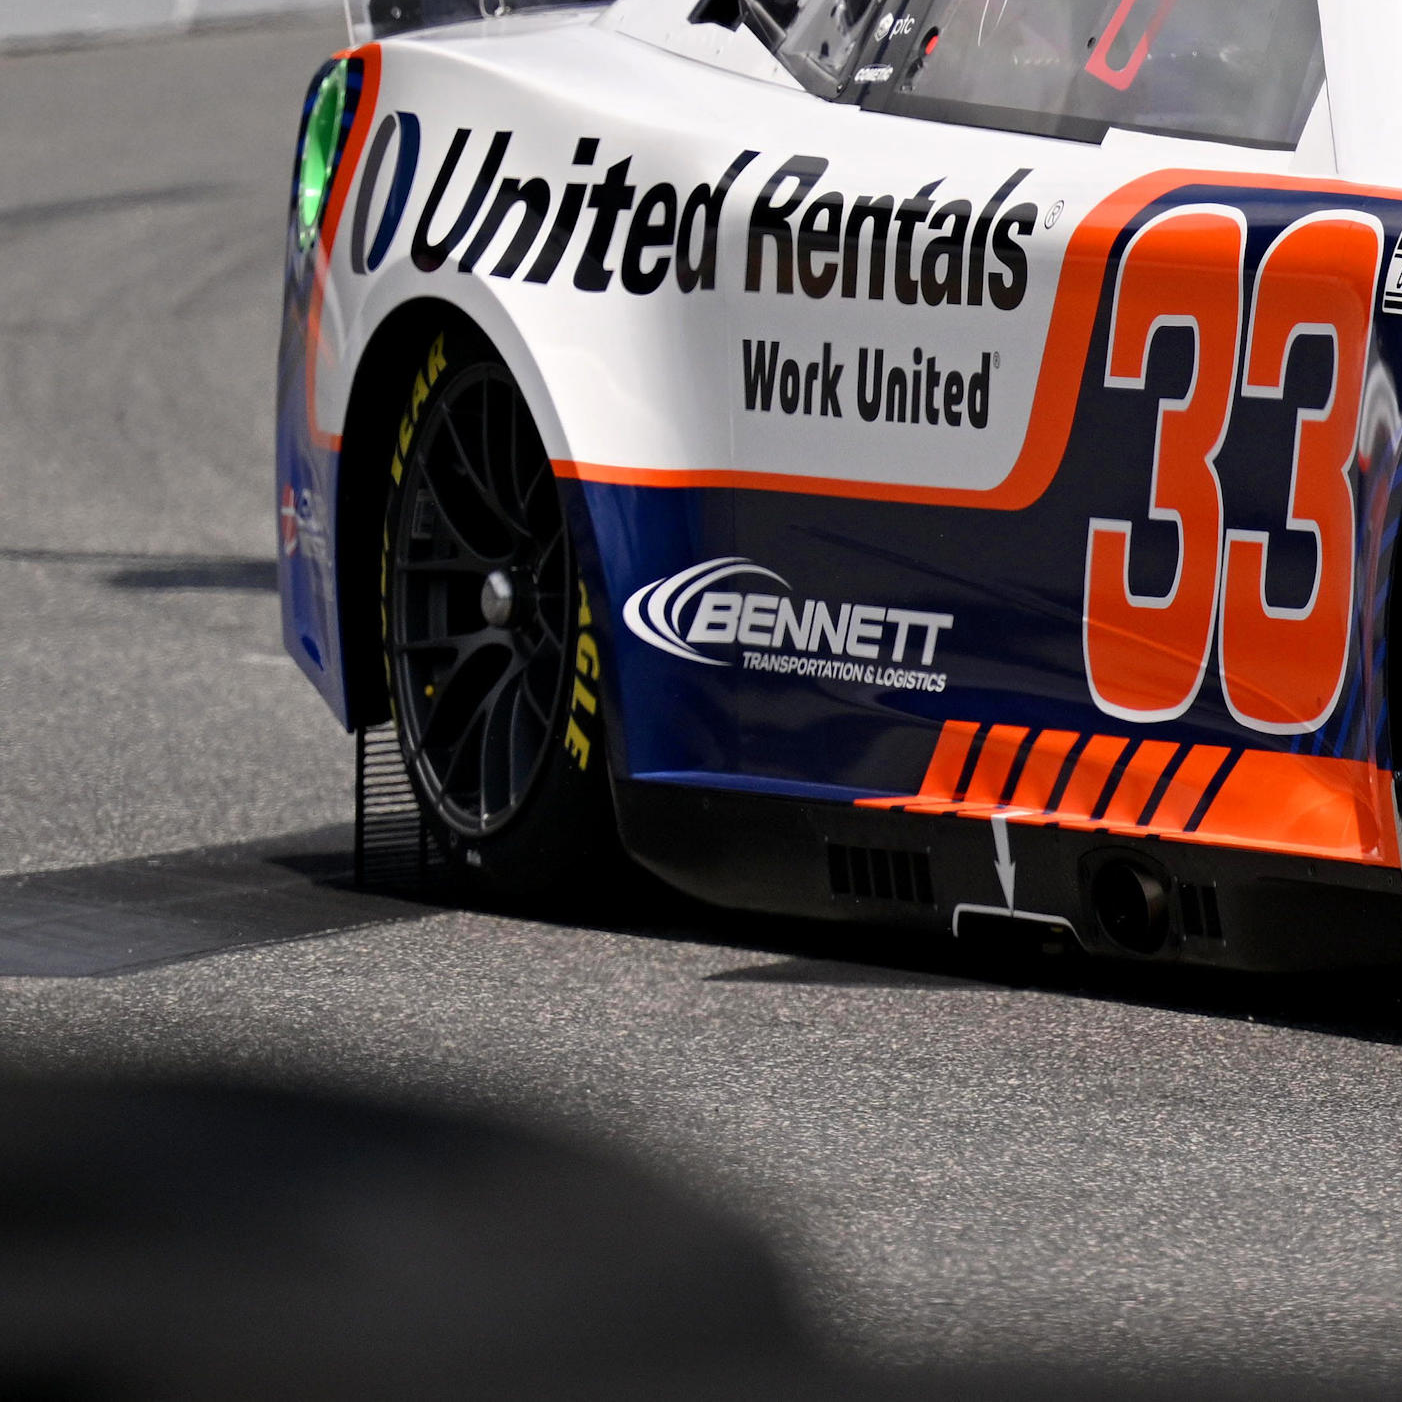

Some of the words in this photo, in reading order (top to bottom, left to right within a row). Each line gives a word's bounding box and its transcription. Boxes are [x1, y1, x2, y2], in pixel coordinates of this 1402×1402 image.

[889, 14, 916, 40] ptc
[410, 126, 761, 296] United
[744, 152, 1038, 311] Rentals
[742, 338, 843, 418] Work
[856, 346, 992, 429] United
[1082, 203, 1385, 735] 33
[566, 572, 600, 772] AGLE
[686, 590, 955, 666] BENNETT
[743, 651, 862, 683] TRANSPORTATION
[864, 667, 876, 684] &
[875, 669, 947, 693] LOGISTICS
